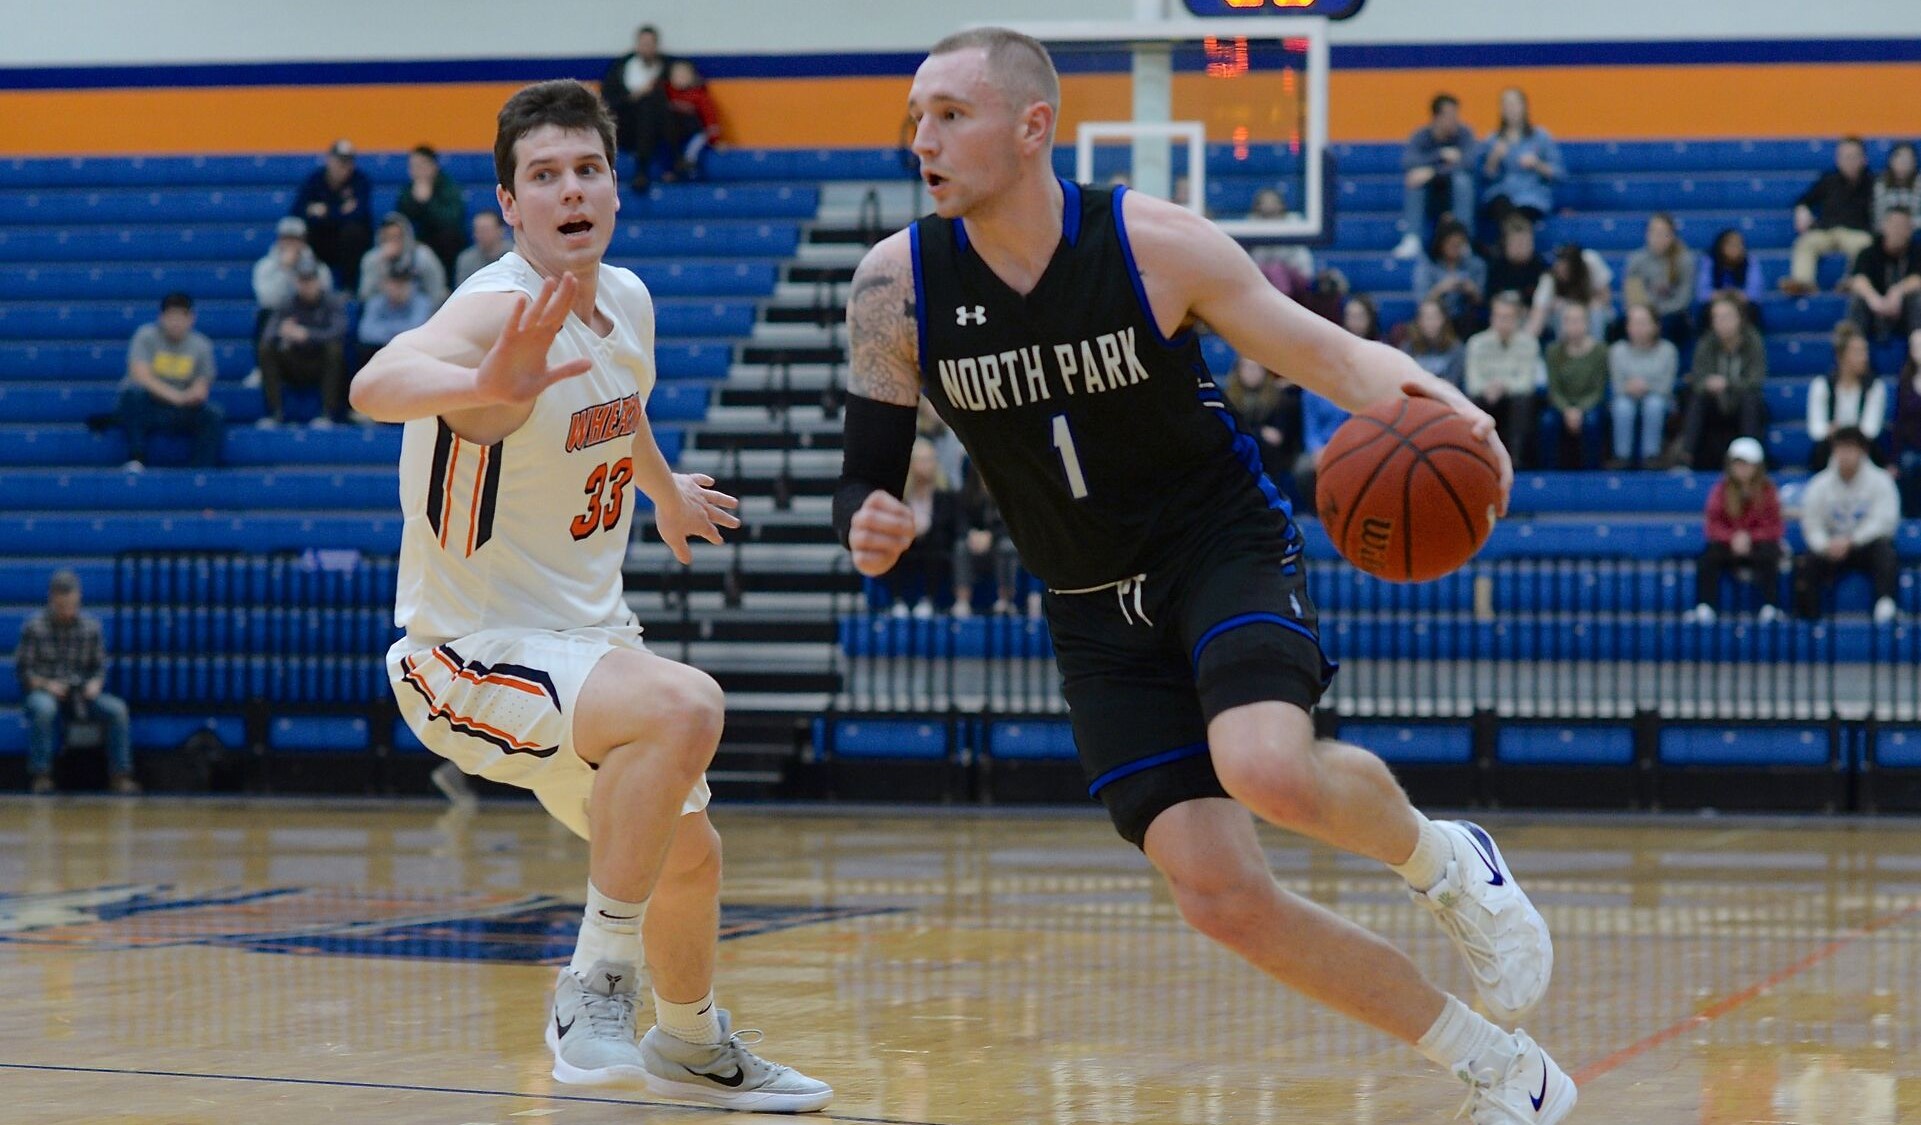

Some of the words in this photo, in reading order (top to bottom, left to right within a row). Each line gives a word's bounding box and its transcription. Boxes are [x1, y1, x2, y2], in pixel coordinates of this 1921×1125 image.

[938, 345, 1050, 411] NORTH
[1053, 326, 1149, 395] PARK
[1051, 412, 1088, 499] 1
[569, 457, 634, 541] 33
